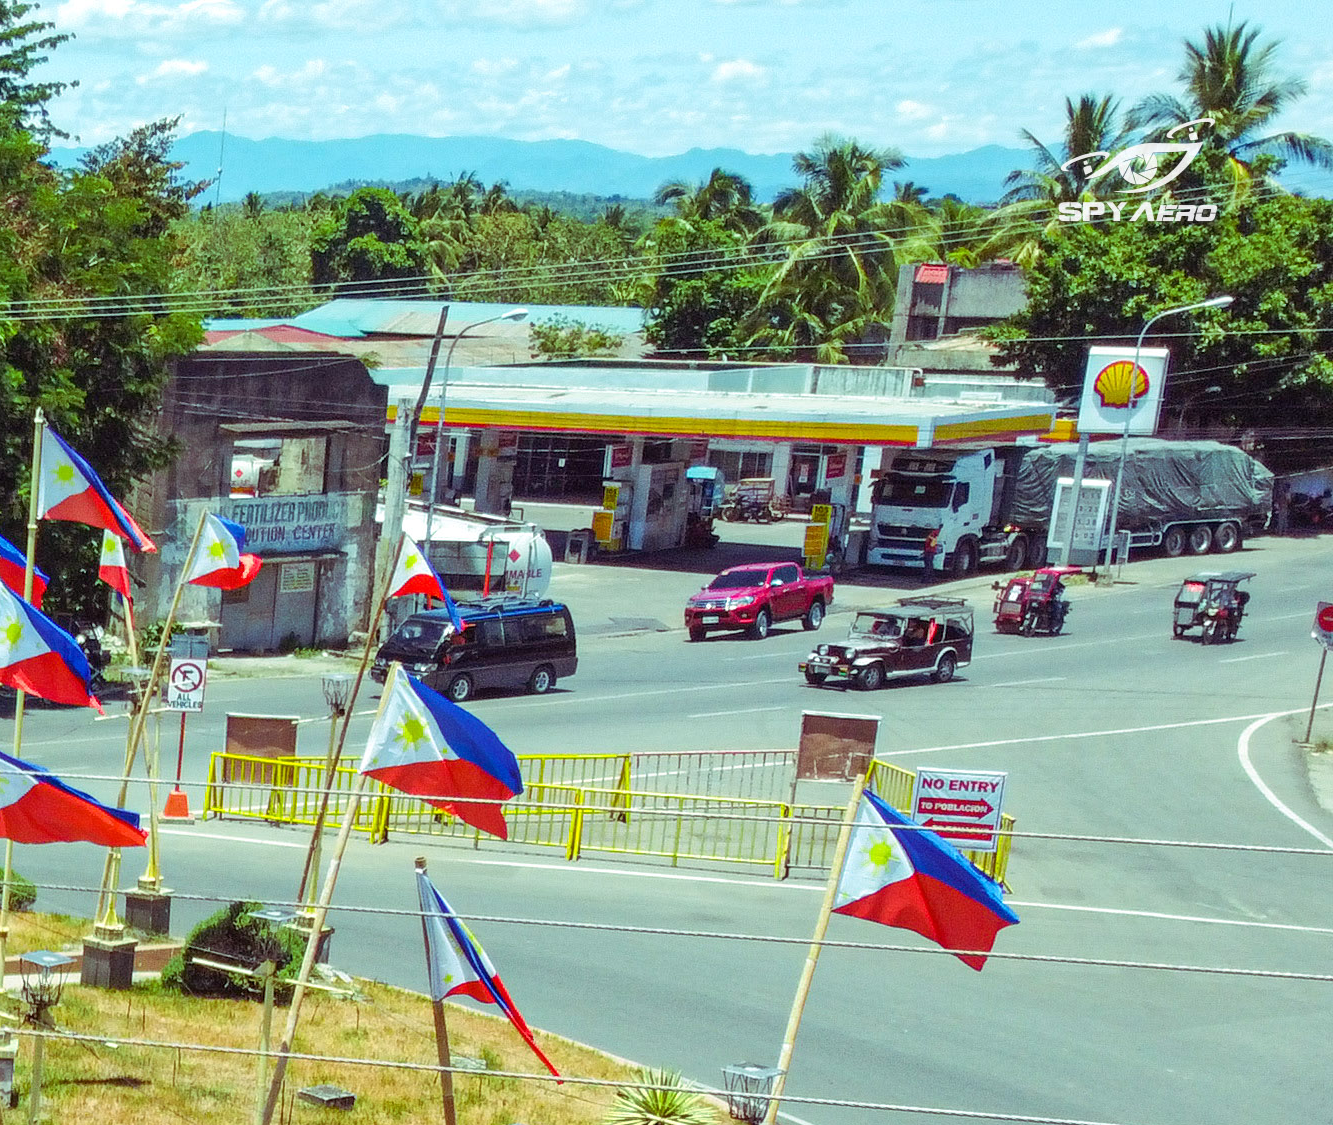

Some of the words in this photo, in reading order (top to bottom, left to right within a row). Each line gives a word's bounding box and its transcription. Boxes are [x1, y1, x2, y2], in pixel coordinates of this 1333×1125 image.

[232, 501, 296, 525] FERTILIZER
[293, 522, 336, 541] CENTER
[176, 692, 191, 702] ALL
[167, 700, 203, 709] VEHICLES
[921, 777, 945, 790] NO
[948, 779, 1000, 793] ENTRY
[920, 801, 933, 810] TO
[934, 801, 989, 813] POBLACION
